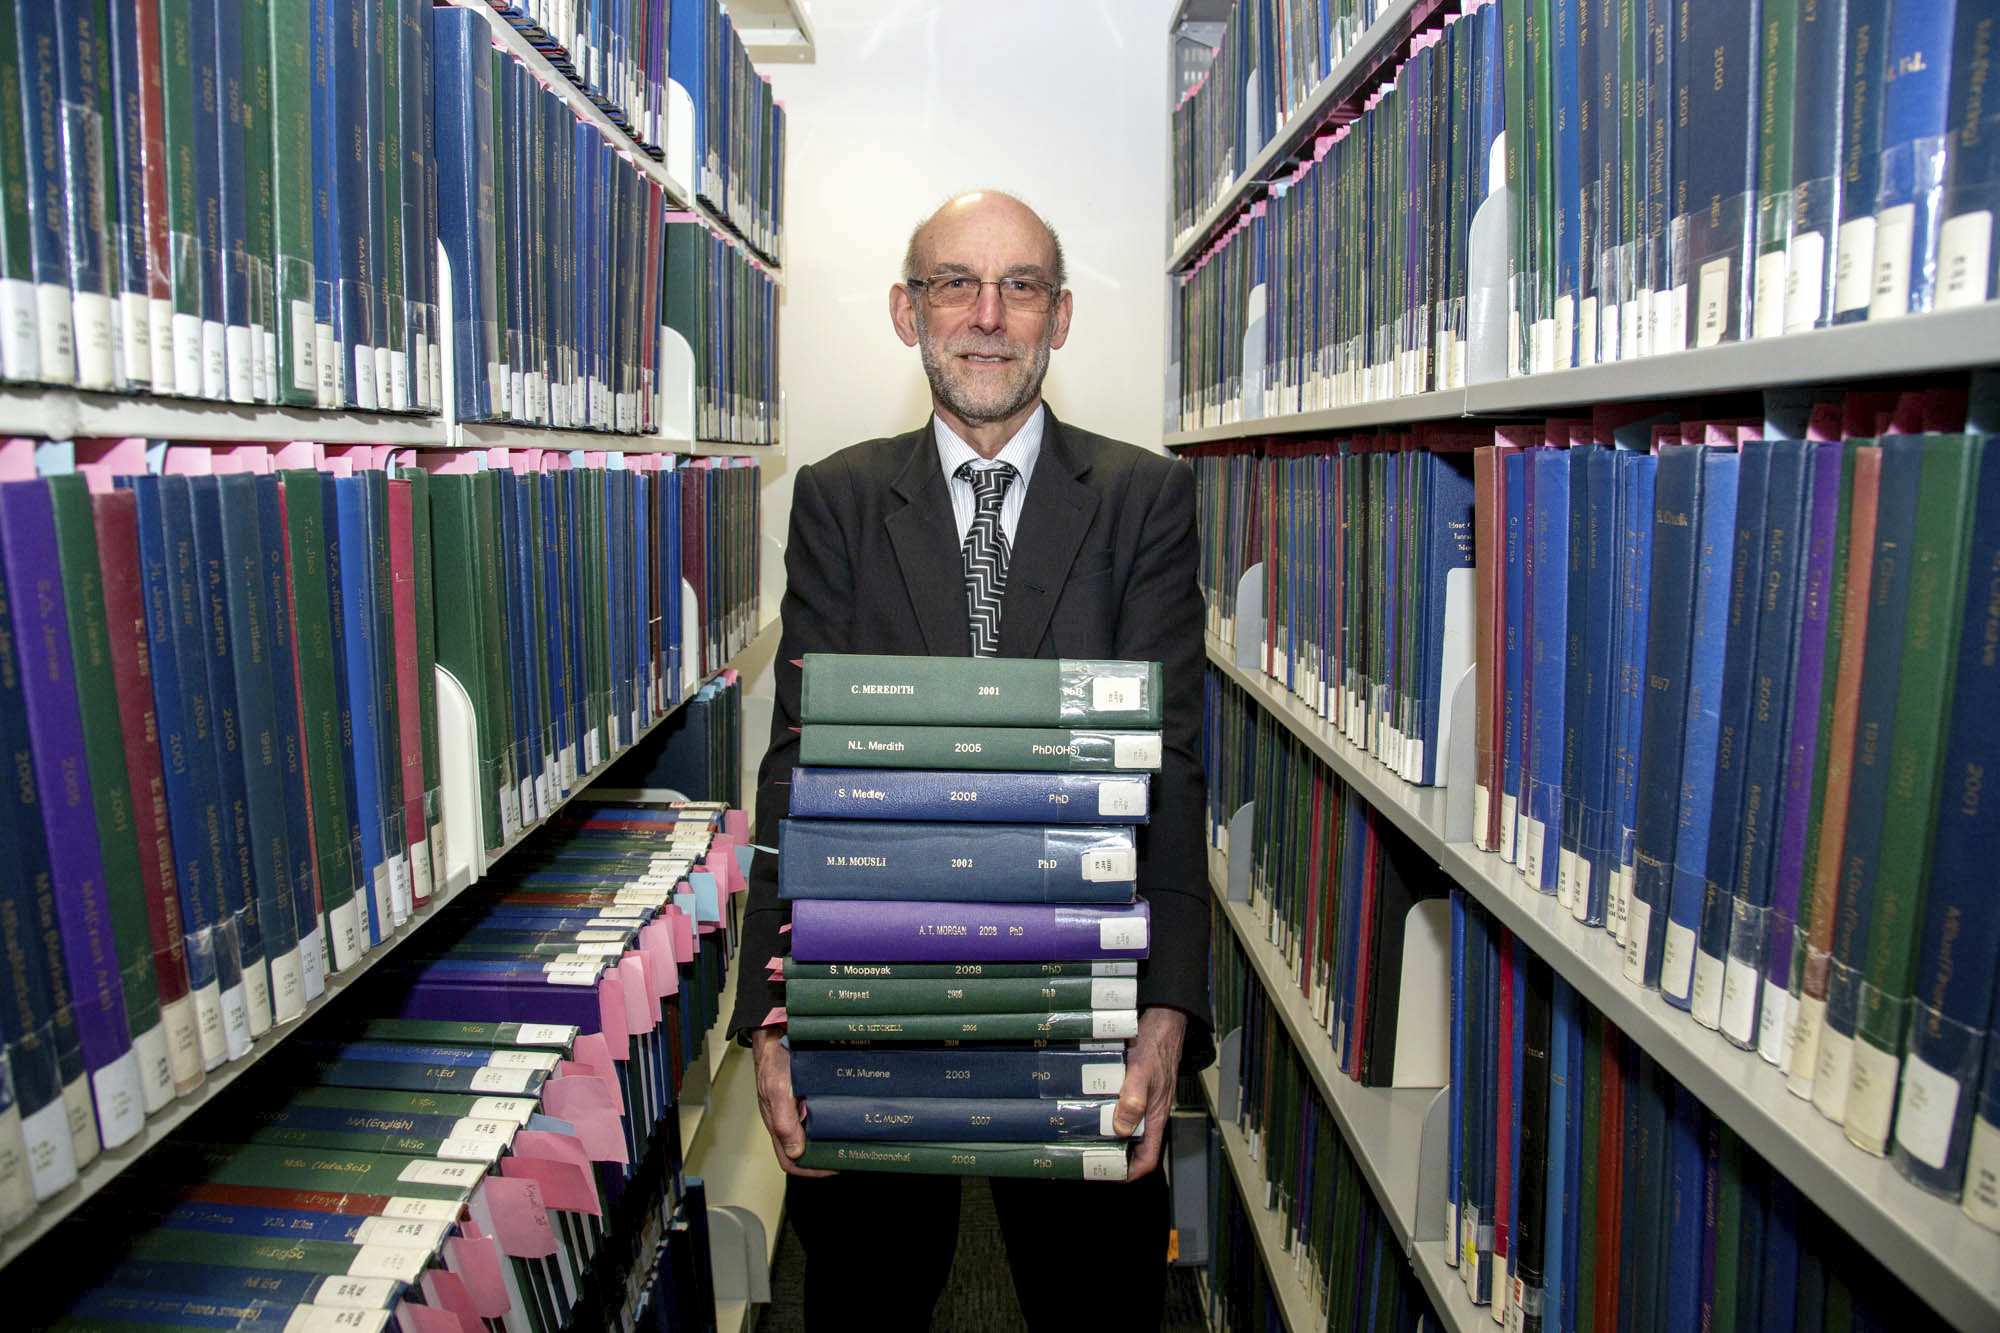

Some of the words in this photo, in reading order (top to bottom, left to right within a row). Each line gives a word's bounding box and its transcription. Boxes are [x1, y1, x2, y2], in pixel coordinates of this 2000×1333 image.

[978, 686, 1000, 697] 2001
[954, 743, 982, 753] 2005
[1032, 743, 1081, 756] PhD(OHS)
[852, 788, 886, 801] Medley
[1048, 793, 1069, 805] PhD
[826, 856, 847, 867] M.M.
[849, 856, 887, 867] MOUSLI
[951, 858, 973, 868] 2002
[1037, 859, 1057, 869] PhD
[936, 925, 967, 936] MORGAN
[1009, 925, 1024, 936] PhD
[830, 965, 840, 975] S.
[844, 964, 892, 977] Moopayak
[1041, 965, 1062, 974] PhD
[945, 1070, 971, 1080] 2003
[1031, 1071, 1051, 1081] PhD
[1033, 1158, 1052, 1169] PhD
